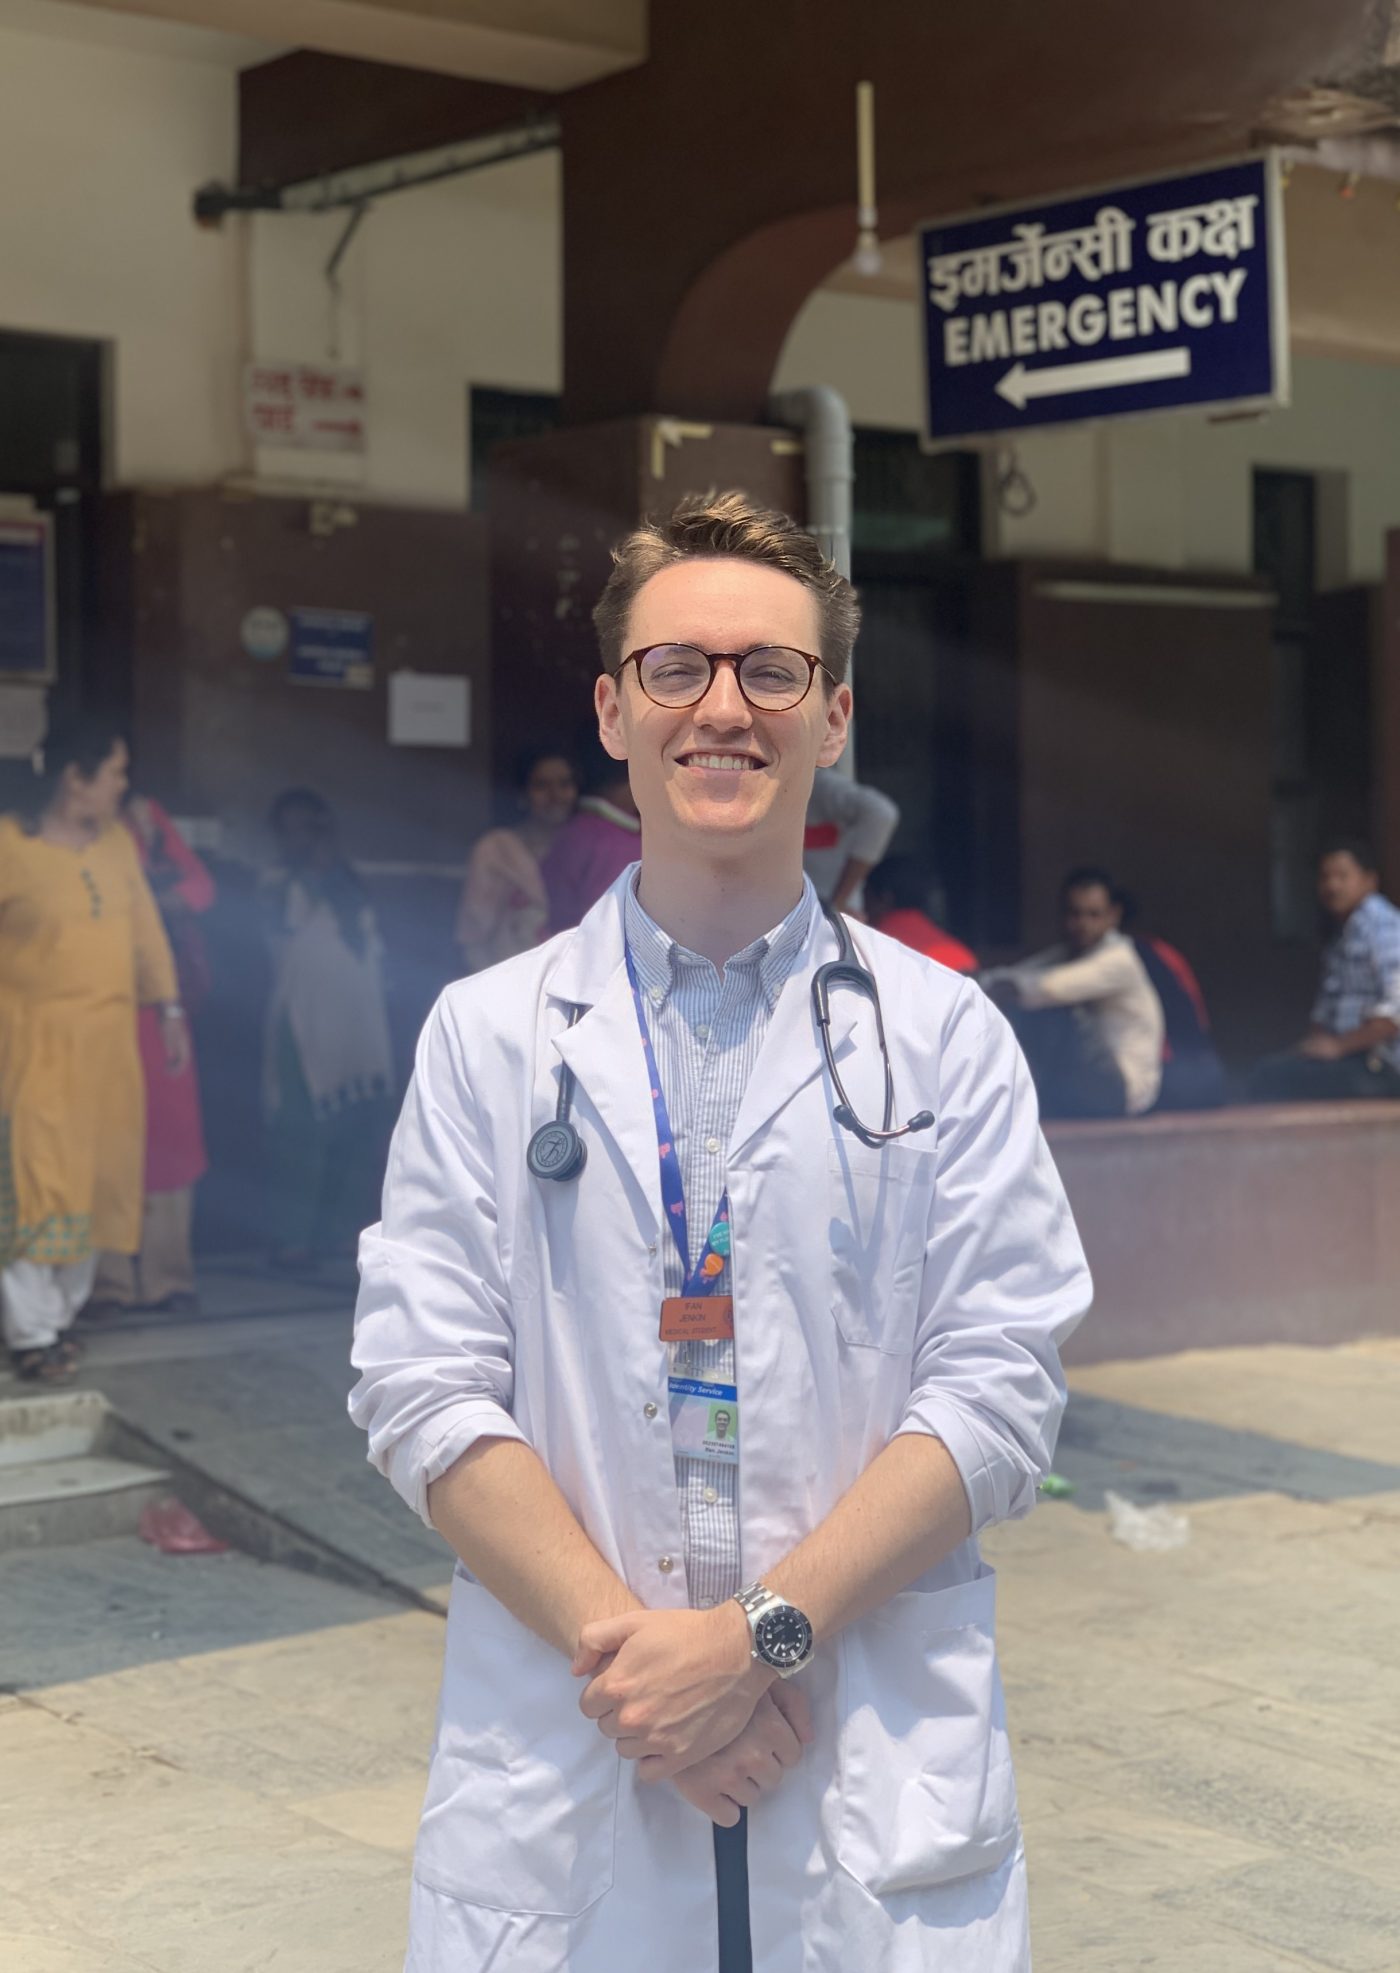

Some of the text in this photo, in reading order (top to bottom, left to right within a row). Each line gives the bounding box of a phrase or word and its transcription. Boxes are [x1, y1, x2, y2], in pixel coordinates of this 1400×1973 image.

[1146, 194, 1259, 260] कक्ष
[944, 268, 1247, 367] EMERGENCY
[697, 1385, 723, 1396] Service
